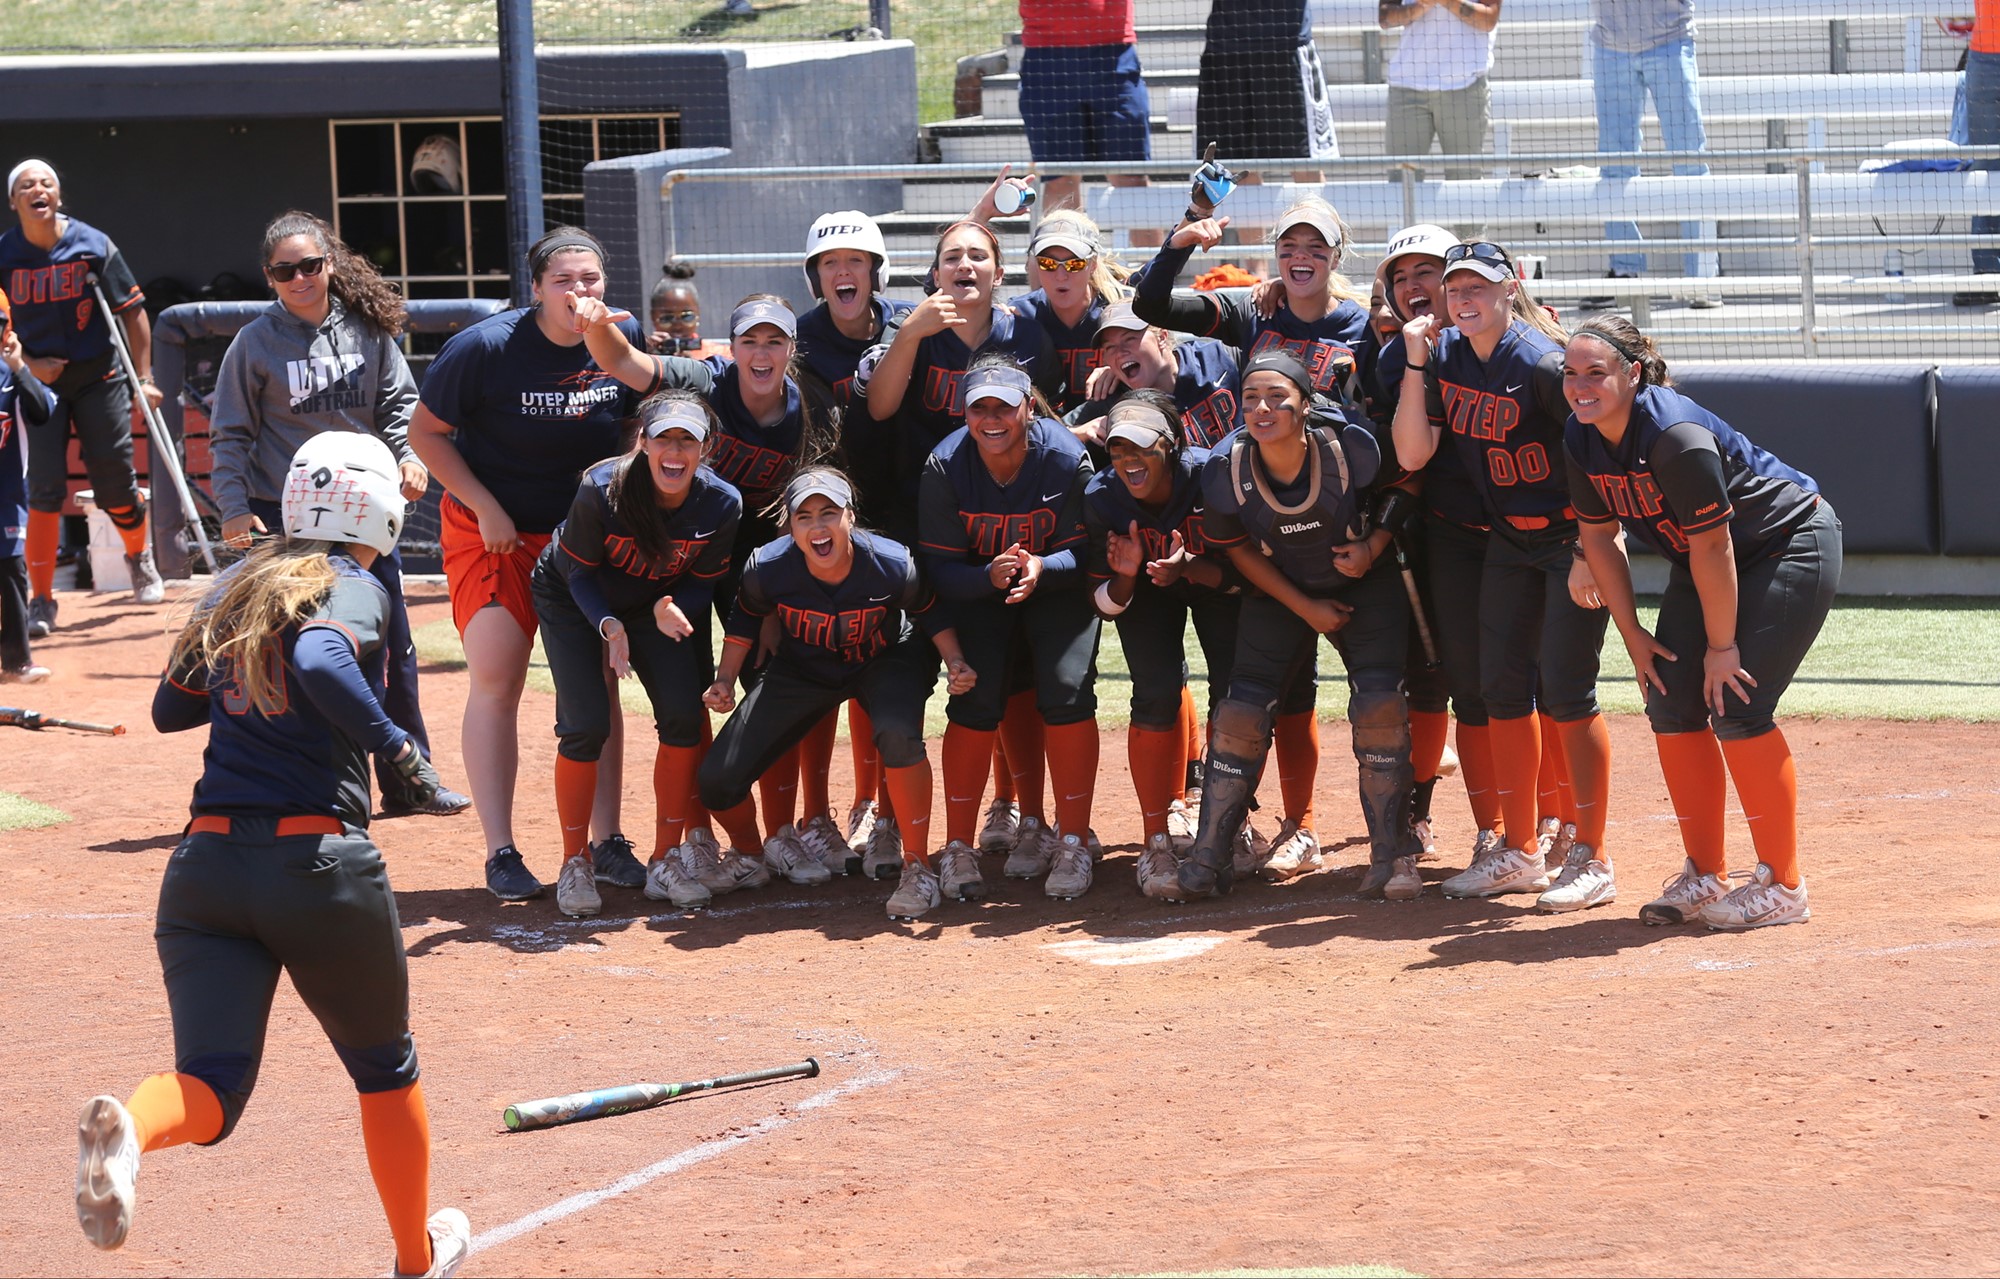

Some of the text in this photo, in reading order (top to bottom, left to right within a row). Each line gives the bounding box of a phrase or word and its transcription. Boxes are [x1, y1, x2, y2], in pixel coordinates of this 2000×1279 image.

[817, 225, 863, 238] UTEP
[1388, 235, 1431, 254] UTEP
[11, 261, 89, 304] UTEP
[76, 298, 93, 331] 9
[290, 390, 367, 415] SOFTBALL
[521, 392, 565, 407] UTEP
[521, 406, 586, 416] SOFTBALL
[1487, 442, 1551, 486] 00
[1280, 520, 1322, 535] Wilson
[778, 603, 887, 652] UTEP
[1365, 753, 1397, 763] Wilson
[1213, 759, 1243, 775] Wilson
